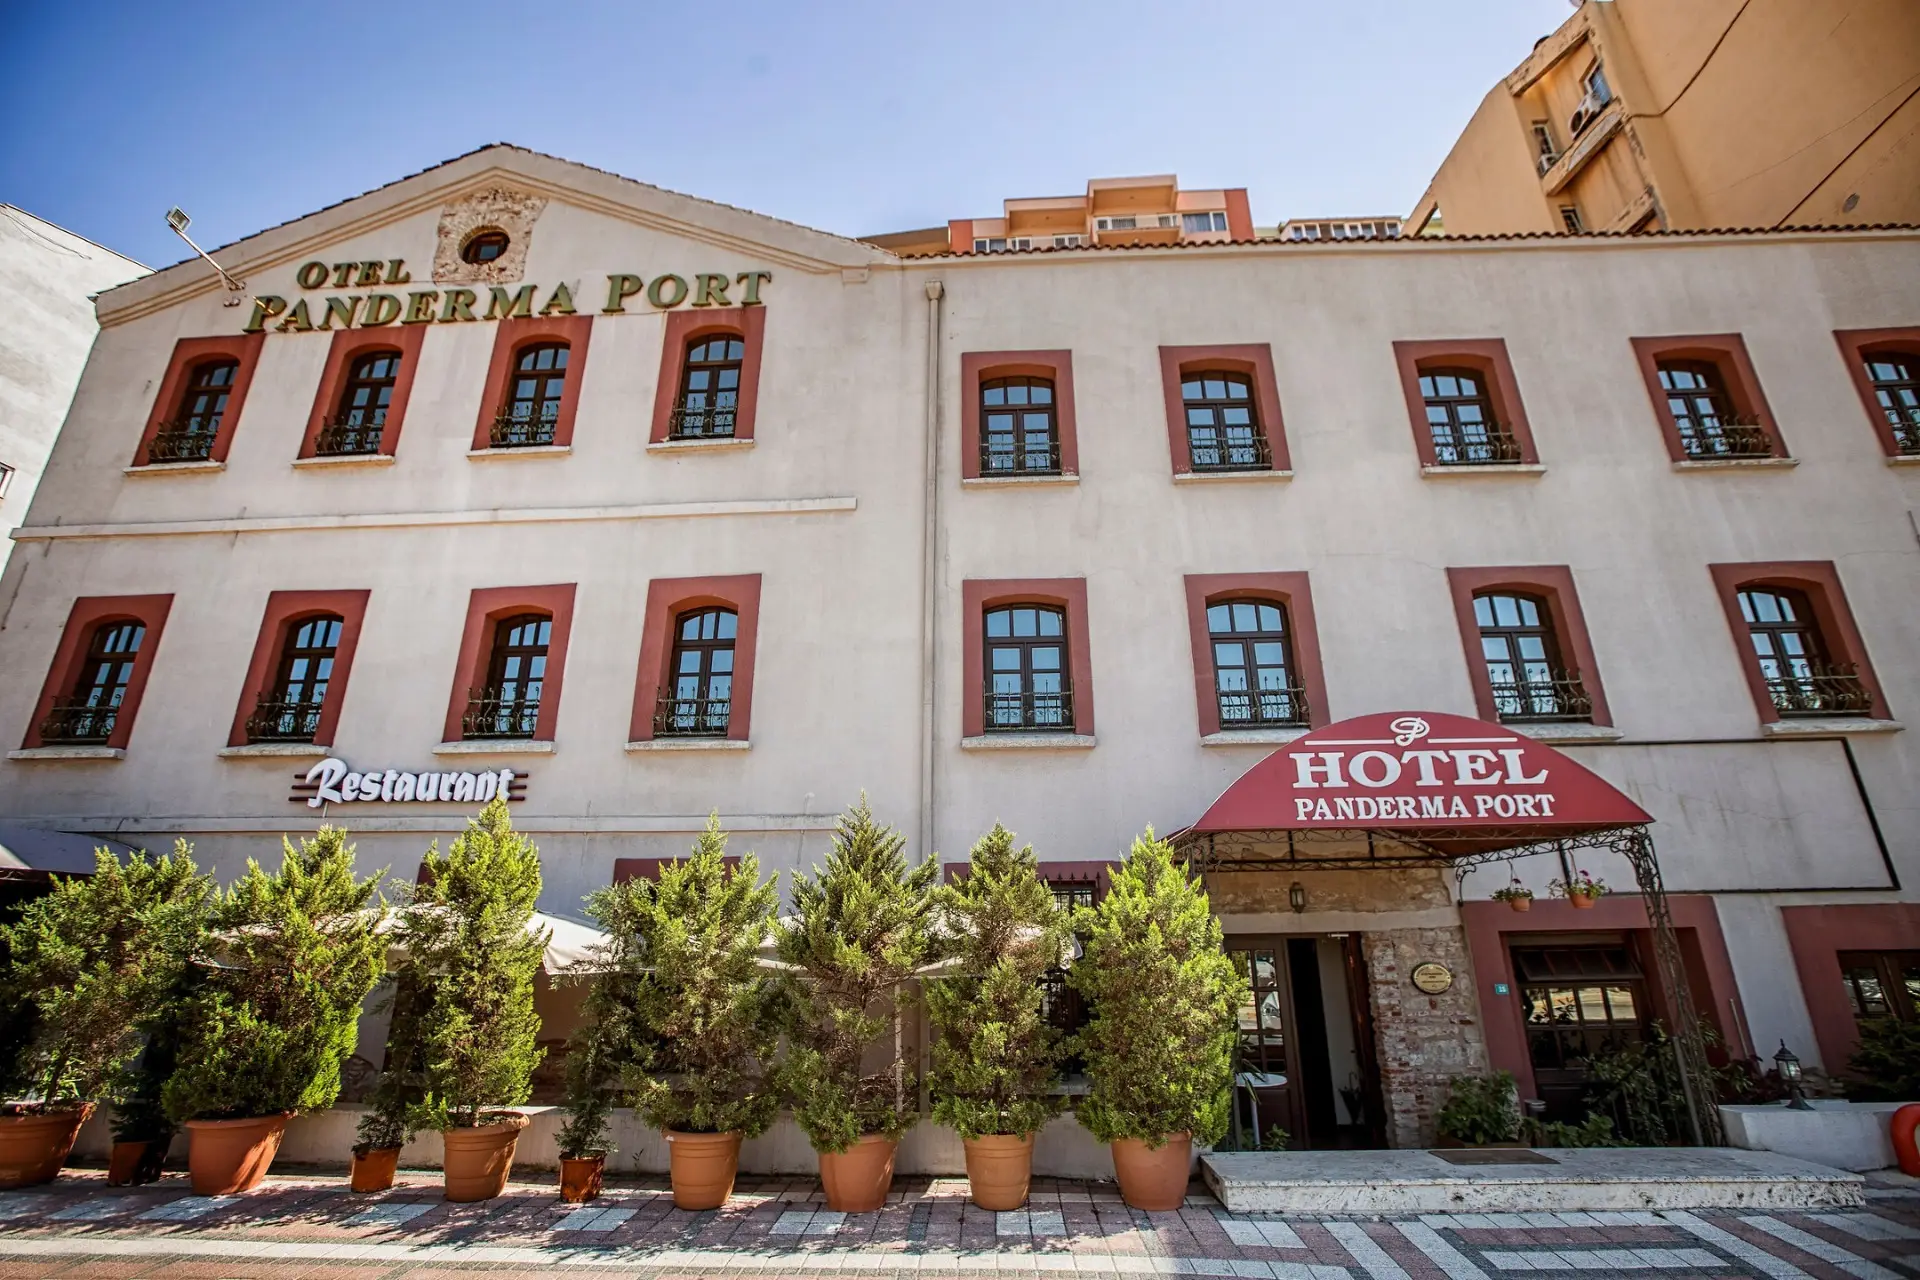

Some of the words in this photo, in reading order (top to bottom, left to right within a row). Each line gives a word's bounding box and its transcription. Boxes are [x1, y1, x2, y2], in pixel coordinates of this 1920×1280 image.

[297, 259, 410, 290] OTEL
[242, 281, 577, 333] PANDERMA
[600, 271, 772, 312] PORT
[305, 757, 515, 808] Restaurant
[1289, 749, 1549, 788] HOTEL
[1295, 797, 1471, 821] PANDERMA
[1474, 793, 1555, 818] PORT
